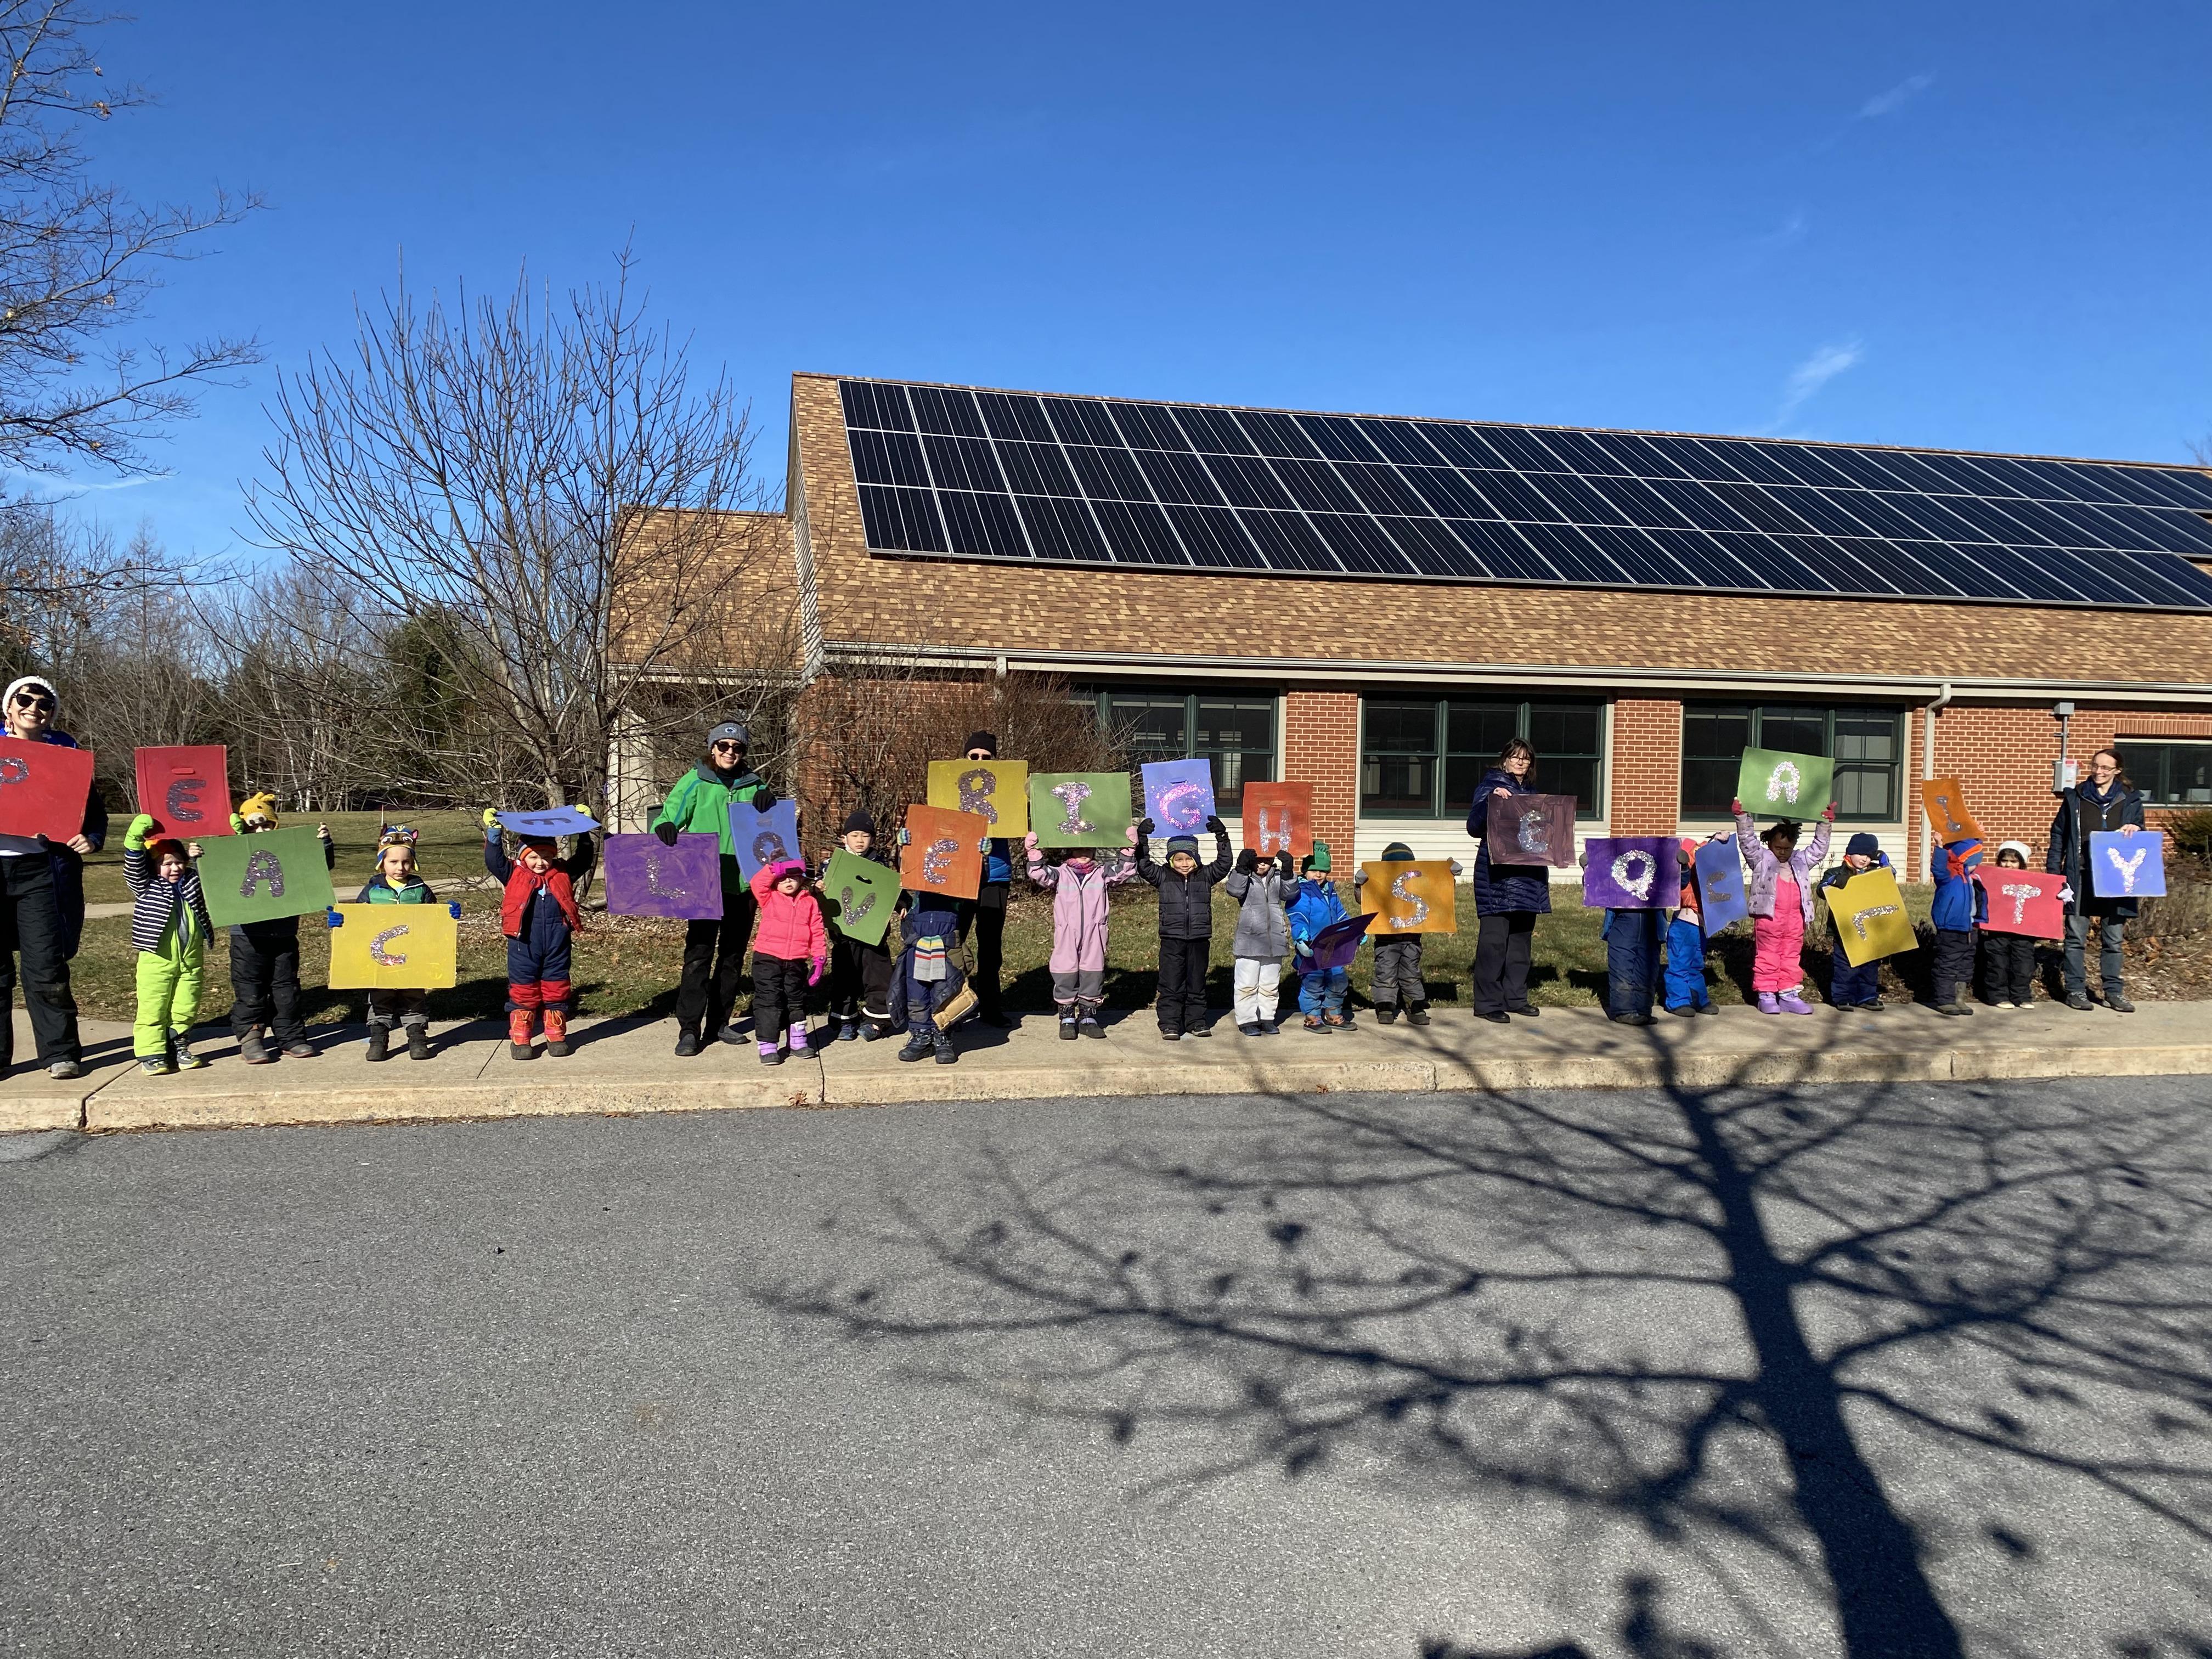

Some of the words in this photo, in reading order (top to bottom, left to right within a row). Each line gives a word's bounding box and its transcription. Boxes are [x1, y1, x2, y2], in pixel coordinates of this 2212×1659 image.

[166, 779, 206, 822] E
[958, 768, 997, 825] R
[1767, 760, 1800, 804] A
[1051, 782, 1097, 835] I
[1159, 783, 1201, 830] G
[1936, 796, 1962, 831] I
[1259, 808, 1293, 853] H
[1517, 810, 1549, 854] E
[239, 850, 285, 898] A
[646, 856, 685, 899] L
[923, 838, 959, 884] E
[1611, 850, 1657, 901] Q
[2107, 848, 2146, 893] Y
[842, 886, 876, 926] V
[1389, 870, 1430, 928] S
[2002, 883, 2041, 924] T
[370, 925, 410, 966] C
